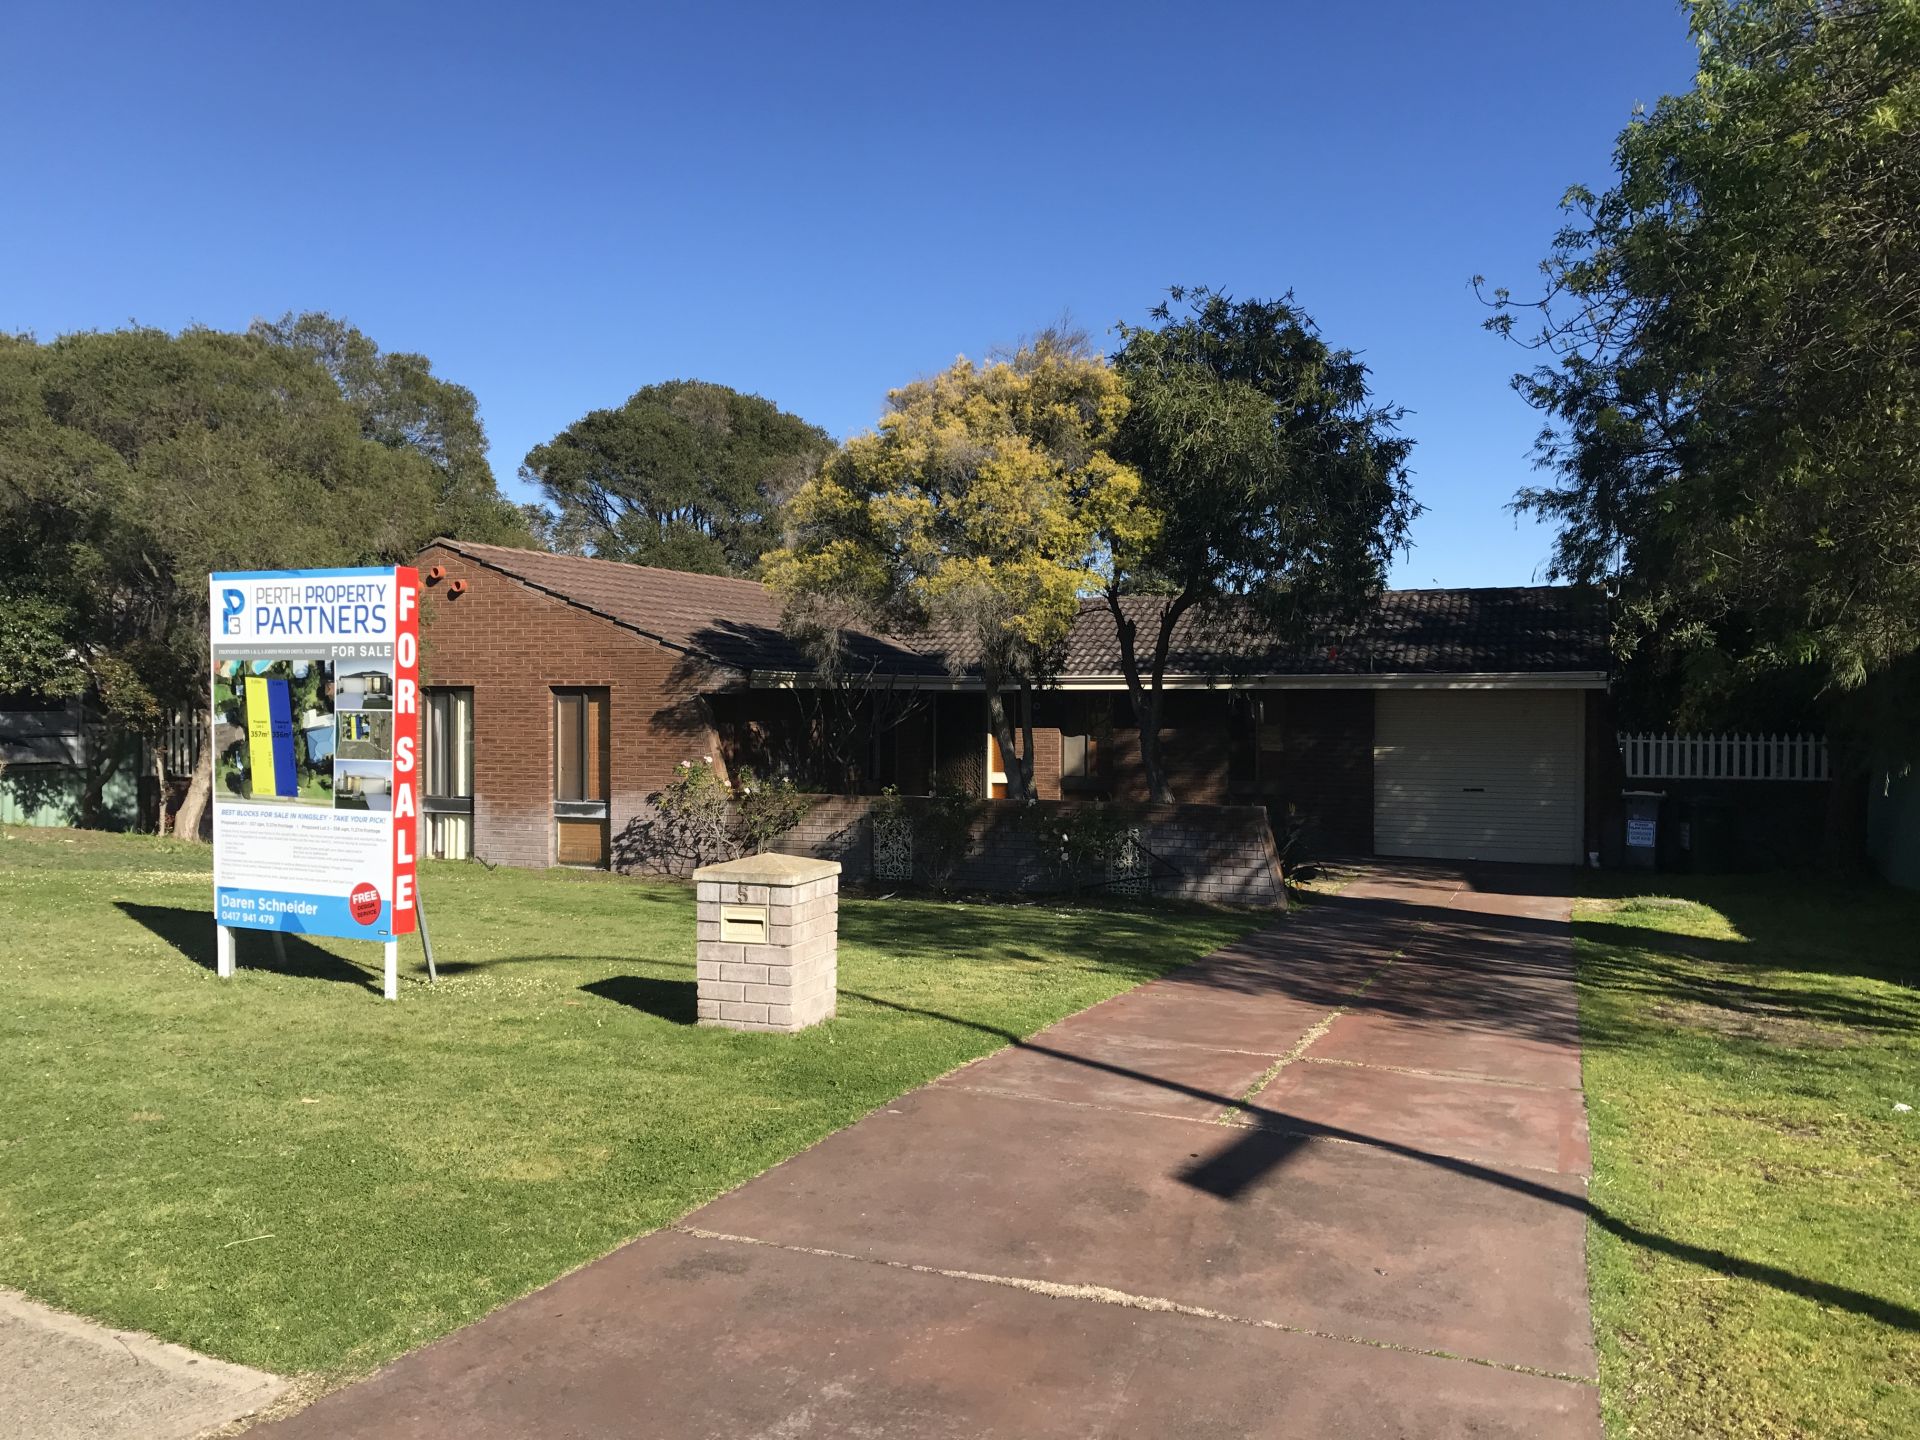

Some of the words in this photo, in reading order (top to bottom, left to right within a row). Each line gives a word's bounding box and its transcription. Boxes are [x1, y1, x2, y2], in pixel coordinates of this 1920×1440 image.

[256, 586, 300, 604] PERTH
[305, 584, 387, 604] PROPERTY
[256, 604, 387, 635] PARTNERS
[331, 646, 356, 657] FOR
[359, 645, 391, 657] SALE
[397, 586, 416, 714] FOR
[237, 810, 259, 818] BLOCKS
[274, 811, 289, 819] SALE
[298, 812, 327, 821] KINGSLEY
[333, 815, 349, 823] TAKE
[350, 816, 368, 824] YOUR
[394, 736, 415, 911] SALE
[352, 890, 377, 905] FREE
[737, 881, 749, 903] 5
[221, 895, 255, 910] Daren
[258, 898, 318, 915] Schneider
[221, 911, 241, 921] 0417
[242, 913, 257, 923] 941
[258, 914, 274, 924] 479
